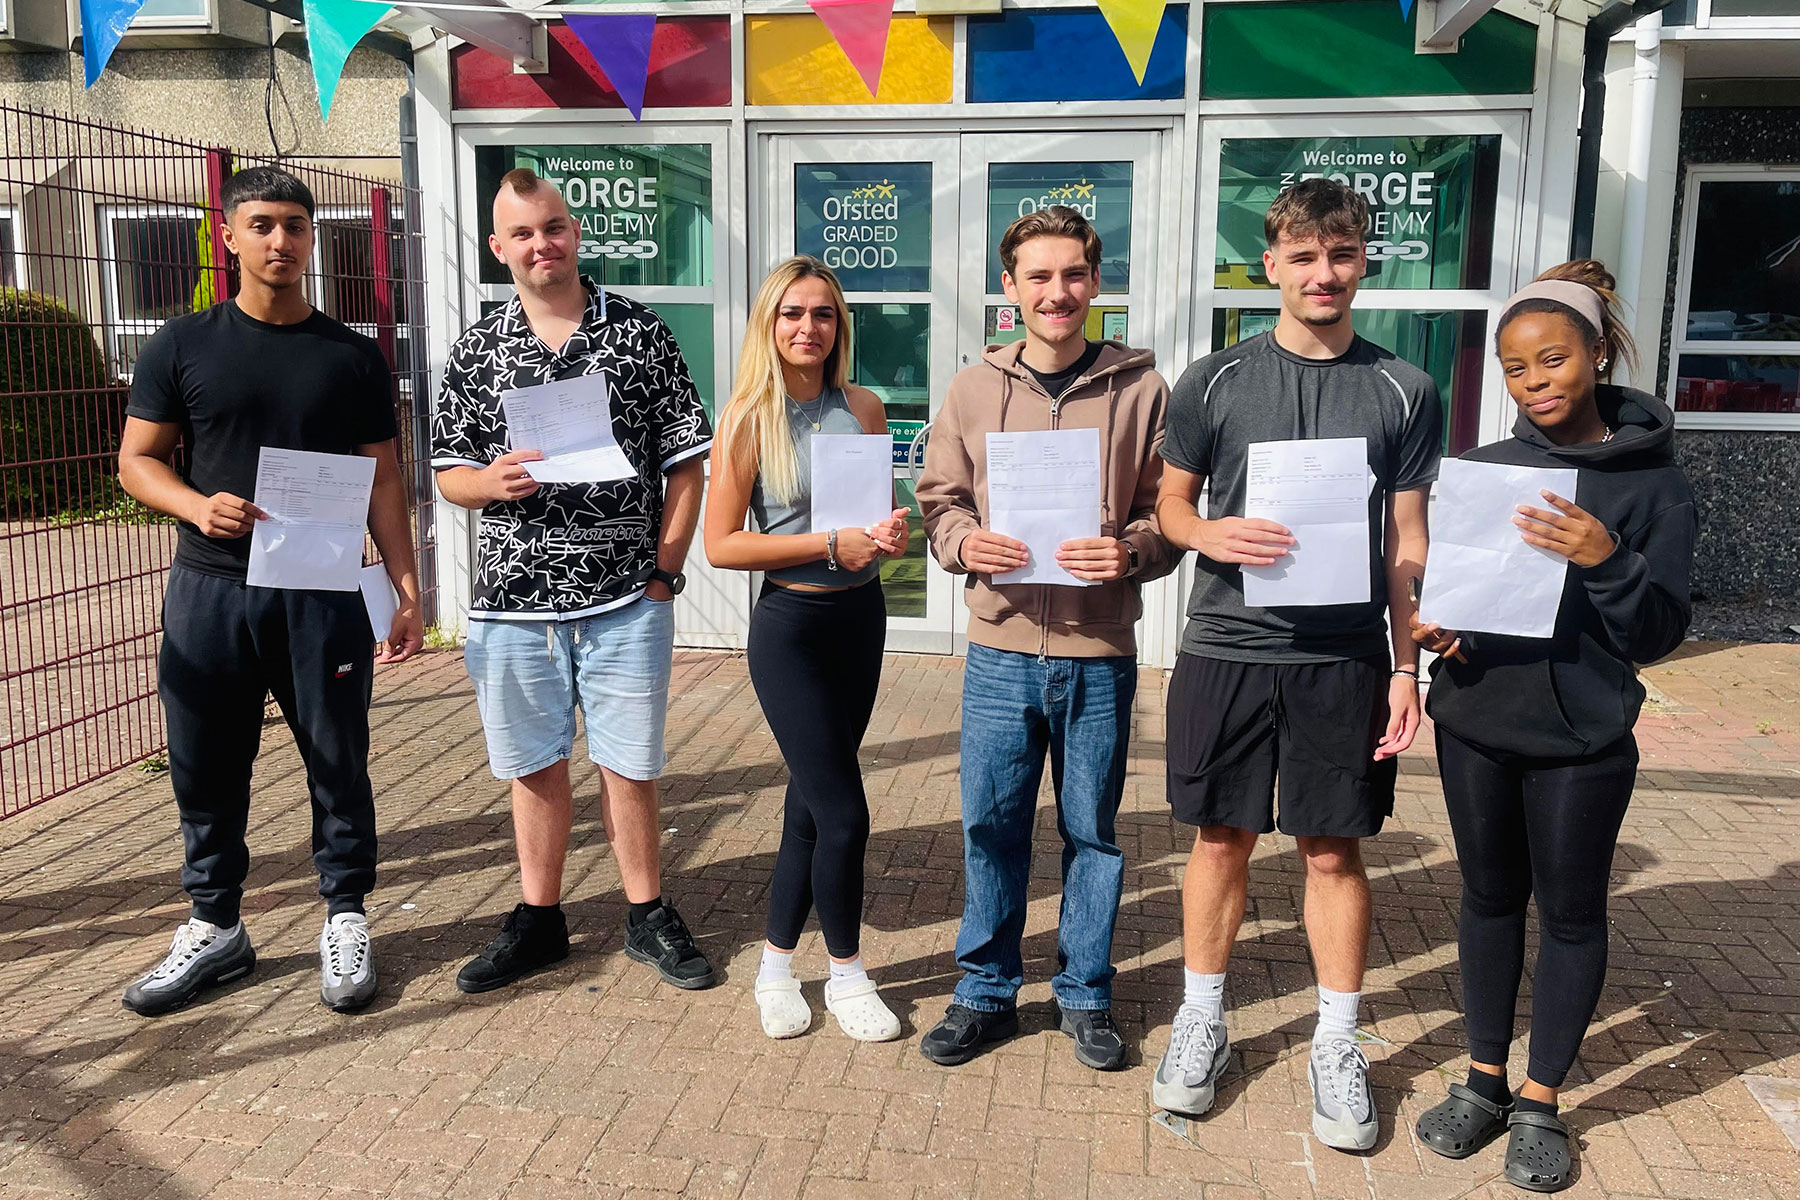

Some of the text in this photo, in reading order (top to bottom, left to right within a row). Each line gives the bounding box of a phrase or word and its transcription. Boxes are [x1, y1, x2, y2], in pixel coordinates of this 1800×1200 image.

[546, 157, 634, 171] Welcome to
[1303, 151, 1407, 166] Welcome to
[1300, 171, 1435, 206] RGE
[823, 195, 899, 221] Ofsted
[571, 213, 658, 235] ADEMY
[823, 225, 898, 242] GRADED
[823, 246, 898, 269] GOOD
[337, 662, 353, 673] NIKE
